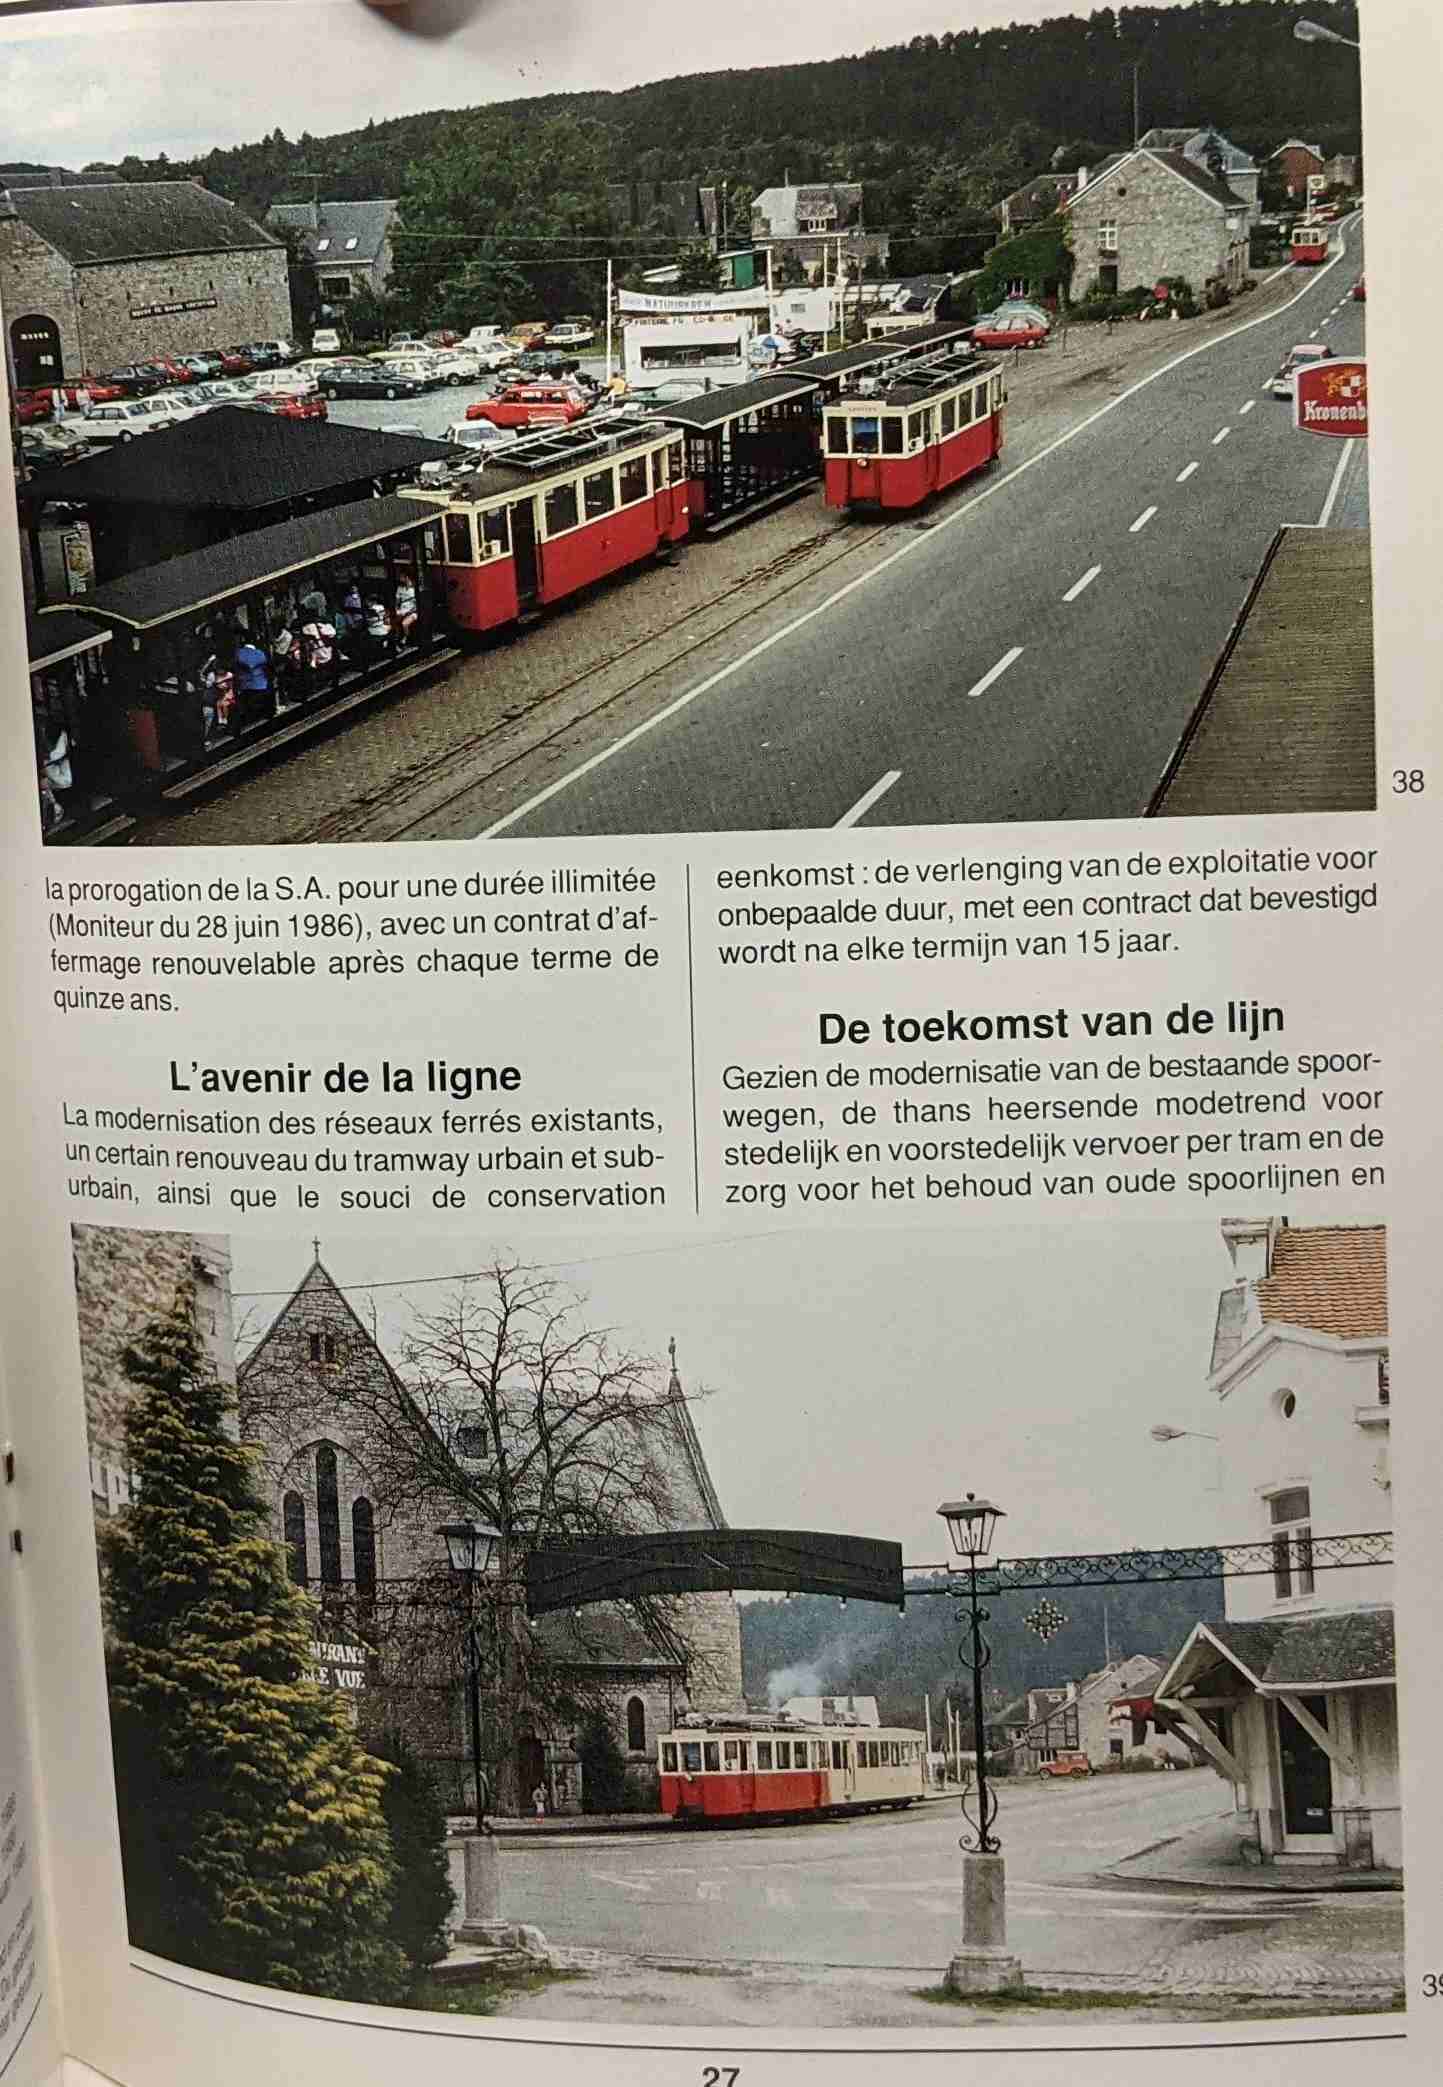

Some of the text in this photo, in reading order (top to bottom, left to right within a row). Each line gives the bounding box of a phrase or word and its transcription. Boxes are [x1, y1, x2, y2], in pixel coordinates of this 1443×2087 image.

[1392, 769, 1424, 793] 38
[45, 866, 657, 908] la prorogation de la S.A. pour une durée illimitée
[716, 862, 856, 889] eenkomst
[874, 859, 910, 885] de
[915, 855, 1062, 887] verlenging
[1068, 858, 1120, 878] van
[1126, 850, 1162, 876] de
[1168, 847, 1310, 881] exploitatie
[1316, 849, 1378, 871] voor
[49, 904, 659, 945] (Moniteur du 28 juin 1986), avec un contrat d'af-
[718, 882, 1377, 932] onbepaalde duur, met een contract dat bevestigd
[50, 942, 660, 981] fermage renouvelable après chaque terme de
[717, 928, 1180, 965] wordt na elke termijn van 15 jaar.
[53, 985, 179, 1014] quinze ans.
[819, 999, 1285, 1045] De toekomst van de lijn
[169, 1060, 522, 1101] L'avenir de la ligne
[722, 1049, 1382, 1091] Gezien de modernisatie van de bestaande spoor-
[63, 1101, 663, 1135] La modernisation des réseaux ferrés existants,
[722, 1086, 1384, 1134] wegen, de thans heersende modetrend voor
[65, 1143, 665, 1178] un certain renouveau du tramway urbain et sub-
[724, 1123, 1384, 1171] stedelijk en voorstedelijk vervoer per tram en de
[68, 1174, 666, 1214] urbain, ainsi que le souci de conservation
[725, 1163, 1385, 1209] zorg voor het behoud van oude spoorlijnen en
[334, 1668, 367, 1688] VUE
[702, 2066, 740, 2087] 27
